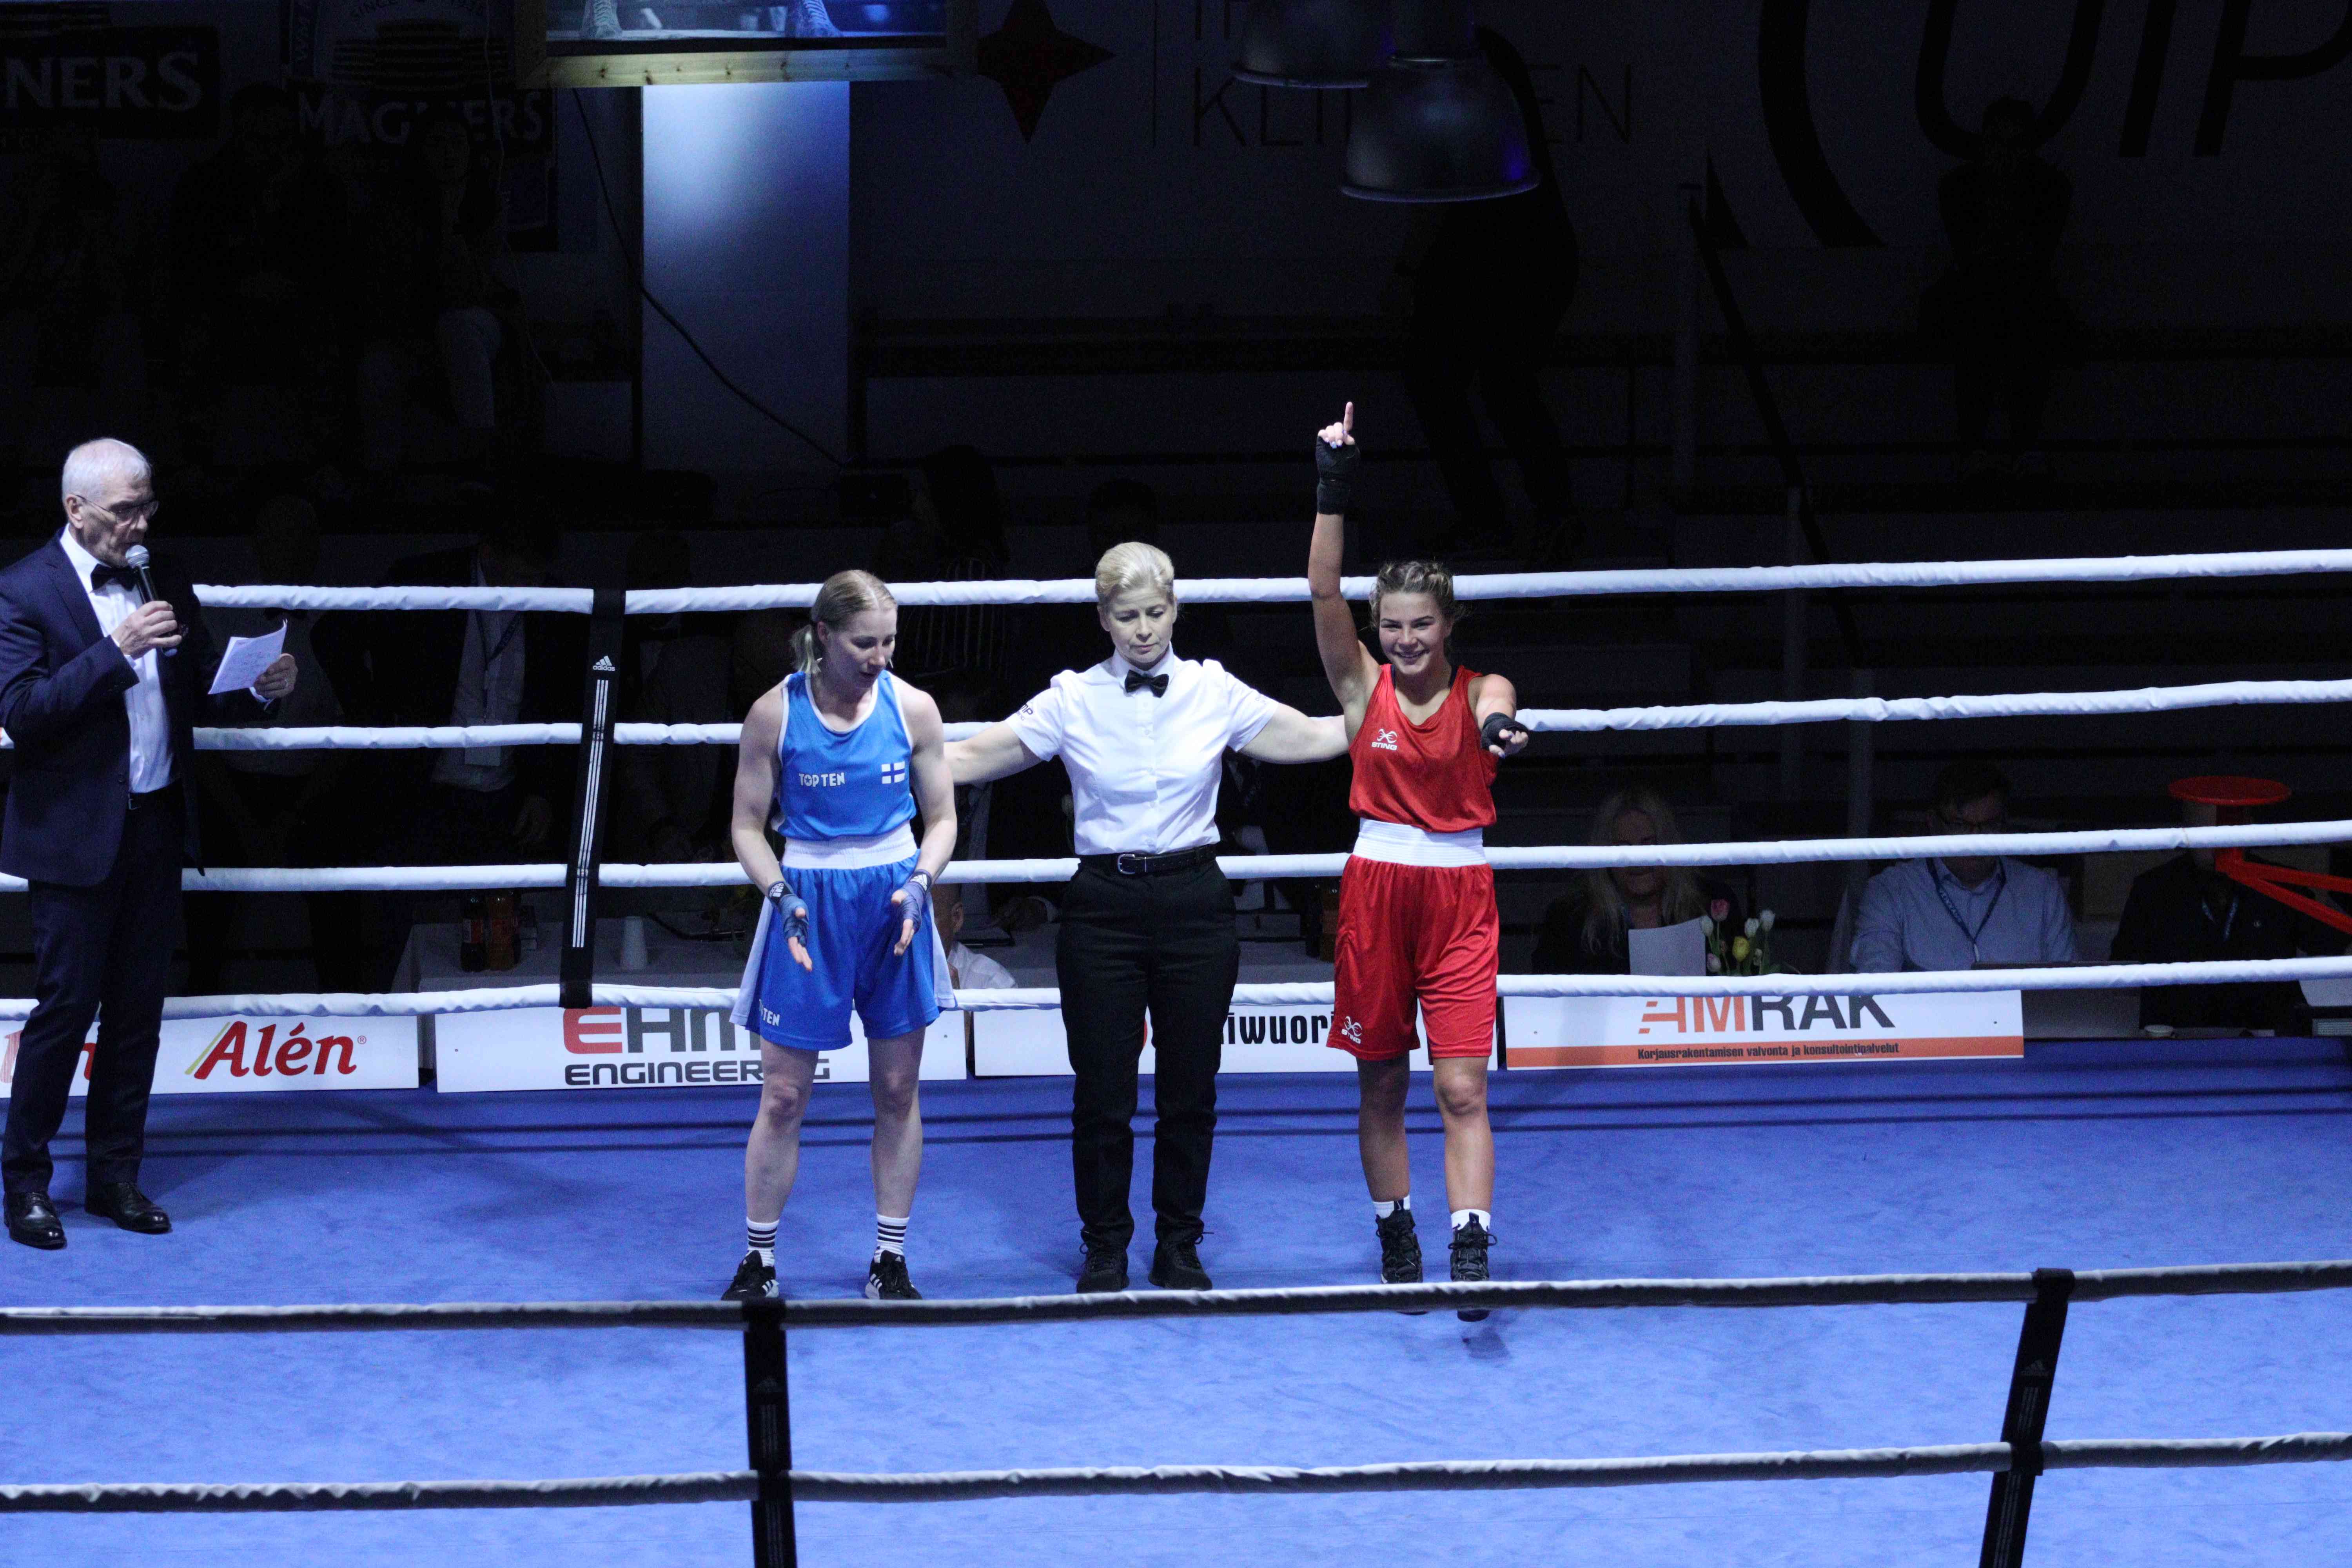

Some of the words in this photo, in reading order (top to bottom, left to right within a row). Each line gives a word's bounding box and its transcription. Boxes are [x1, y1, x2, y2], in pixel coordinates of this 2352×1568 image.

[298, 89, 543, 145] MAGERS
[799, 773, 819, 787] TOP
[821, 772, 845, 787] TEN
[1638, 1047, 1743, 1060] Korjausrakentamisen
[1747, 1045, 1788, 1056] valvonta
[1791, 1045, 1800, 1057] ja
[1804, 1043, 1899, 1055] konsultointipalvelut
[565, 1058, 829, 1085] ENGINEERG
